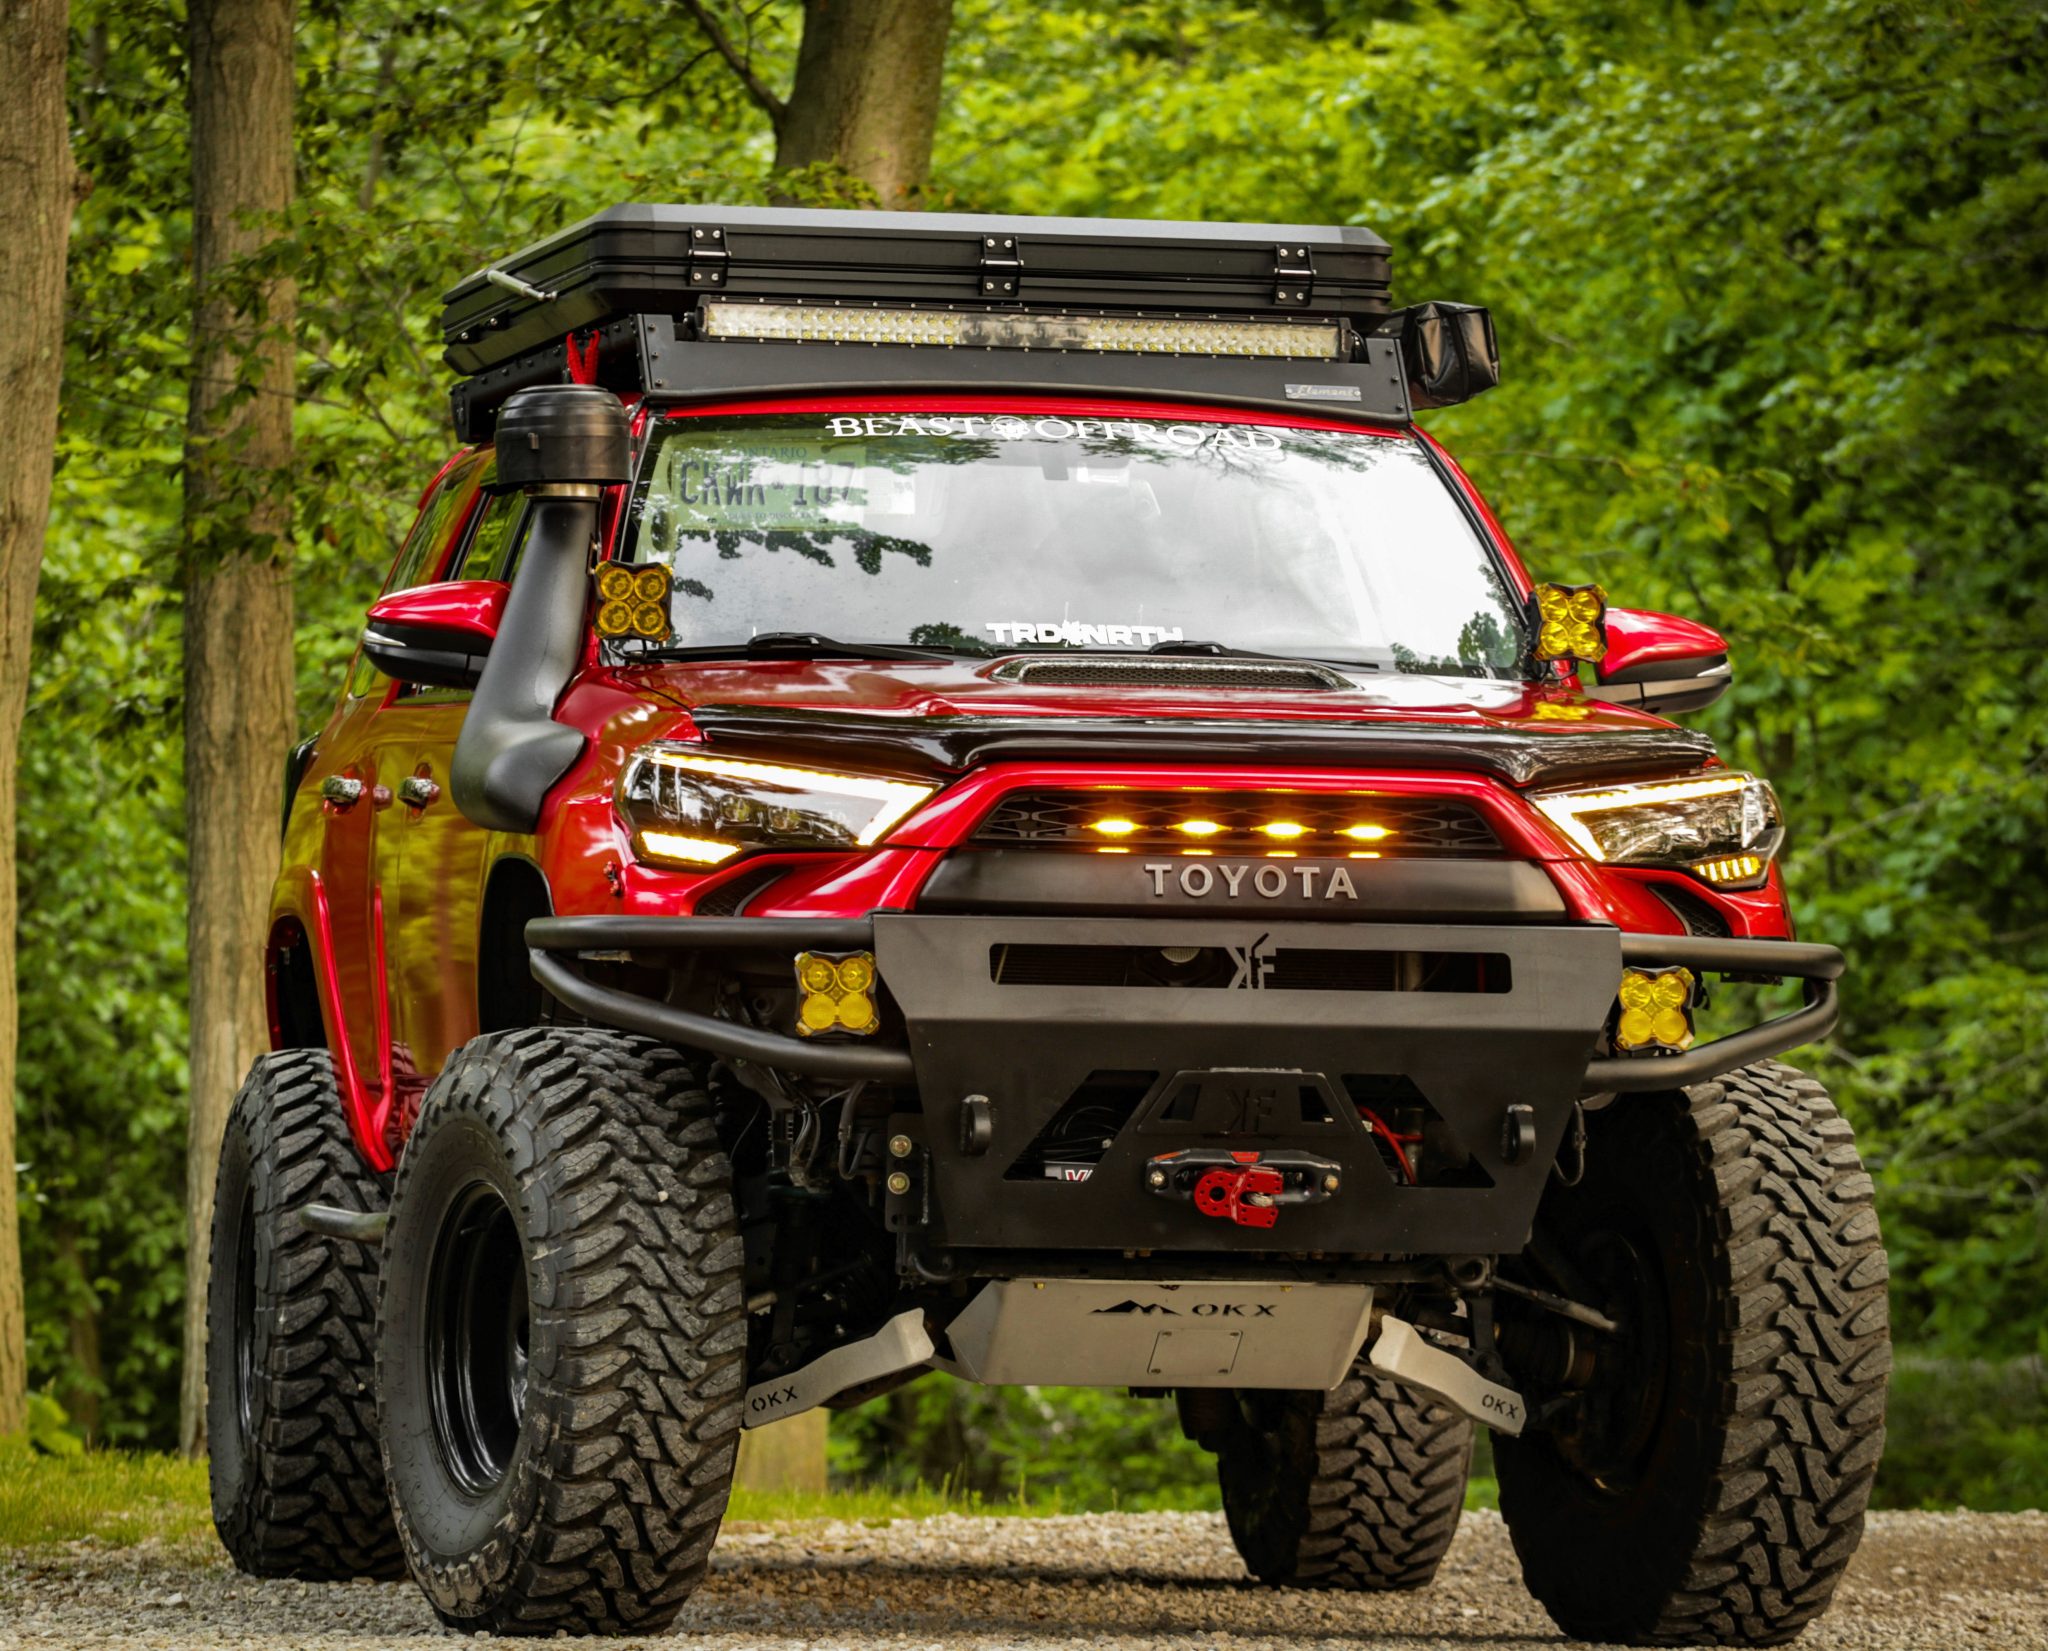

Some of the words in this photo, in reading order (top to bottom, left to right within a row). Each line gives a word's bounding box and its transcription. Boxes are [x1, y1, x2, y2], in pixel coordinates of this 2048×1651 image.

[824, 416, 986, 437] BEAST
[1034, 418, 1283, 451] OFFROAD
[985, 622, 1060, 643] TRD
[1144, 863, 1358, 900] TOYOTA
[1192, 1303, 1278, 1317] OKX
[752, 1385, 798, 1412] OKX
[1482, 1393, 1519, 1419] OKX
